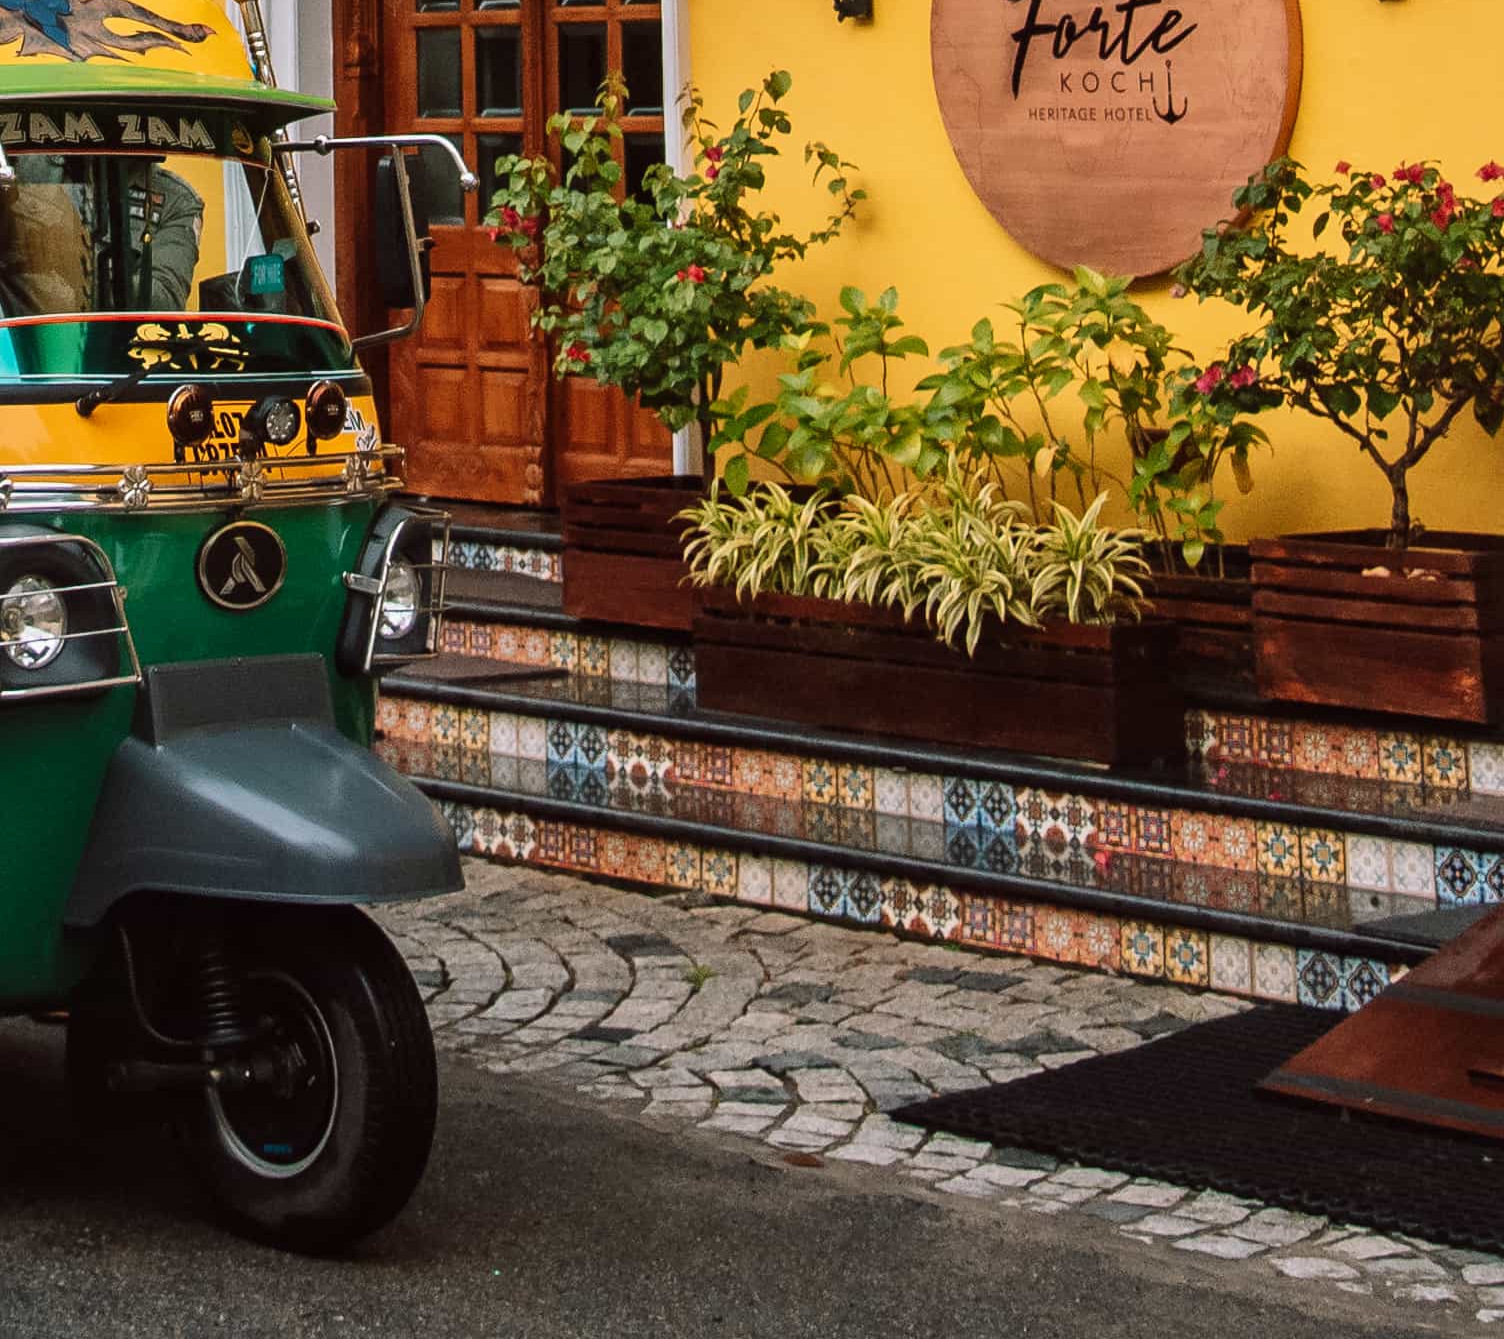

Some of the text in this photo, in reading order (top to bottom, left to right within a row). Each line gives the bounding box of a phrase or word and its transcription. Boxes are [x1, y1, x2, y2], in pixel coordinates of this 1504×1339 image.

[1029, 106, 1153, 121] HERITAGE HOTEL
[118, 114, 216, 149] ZAM
